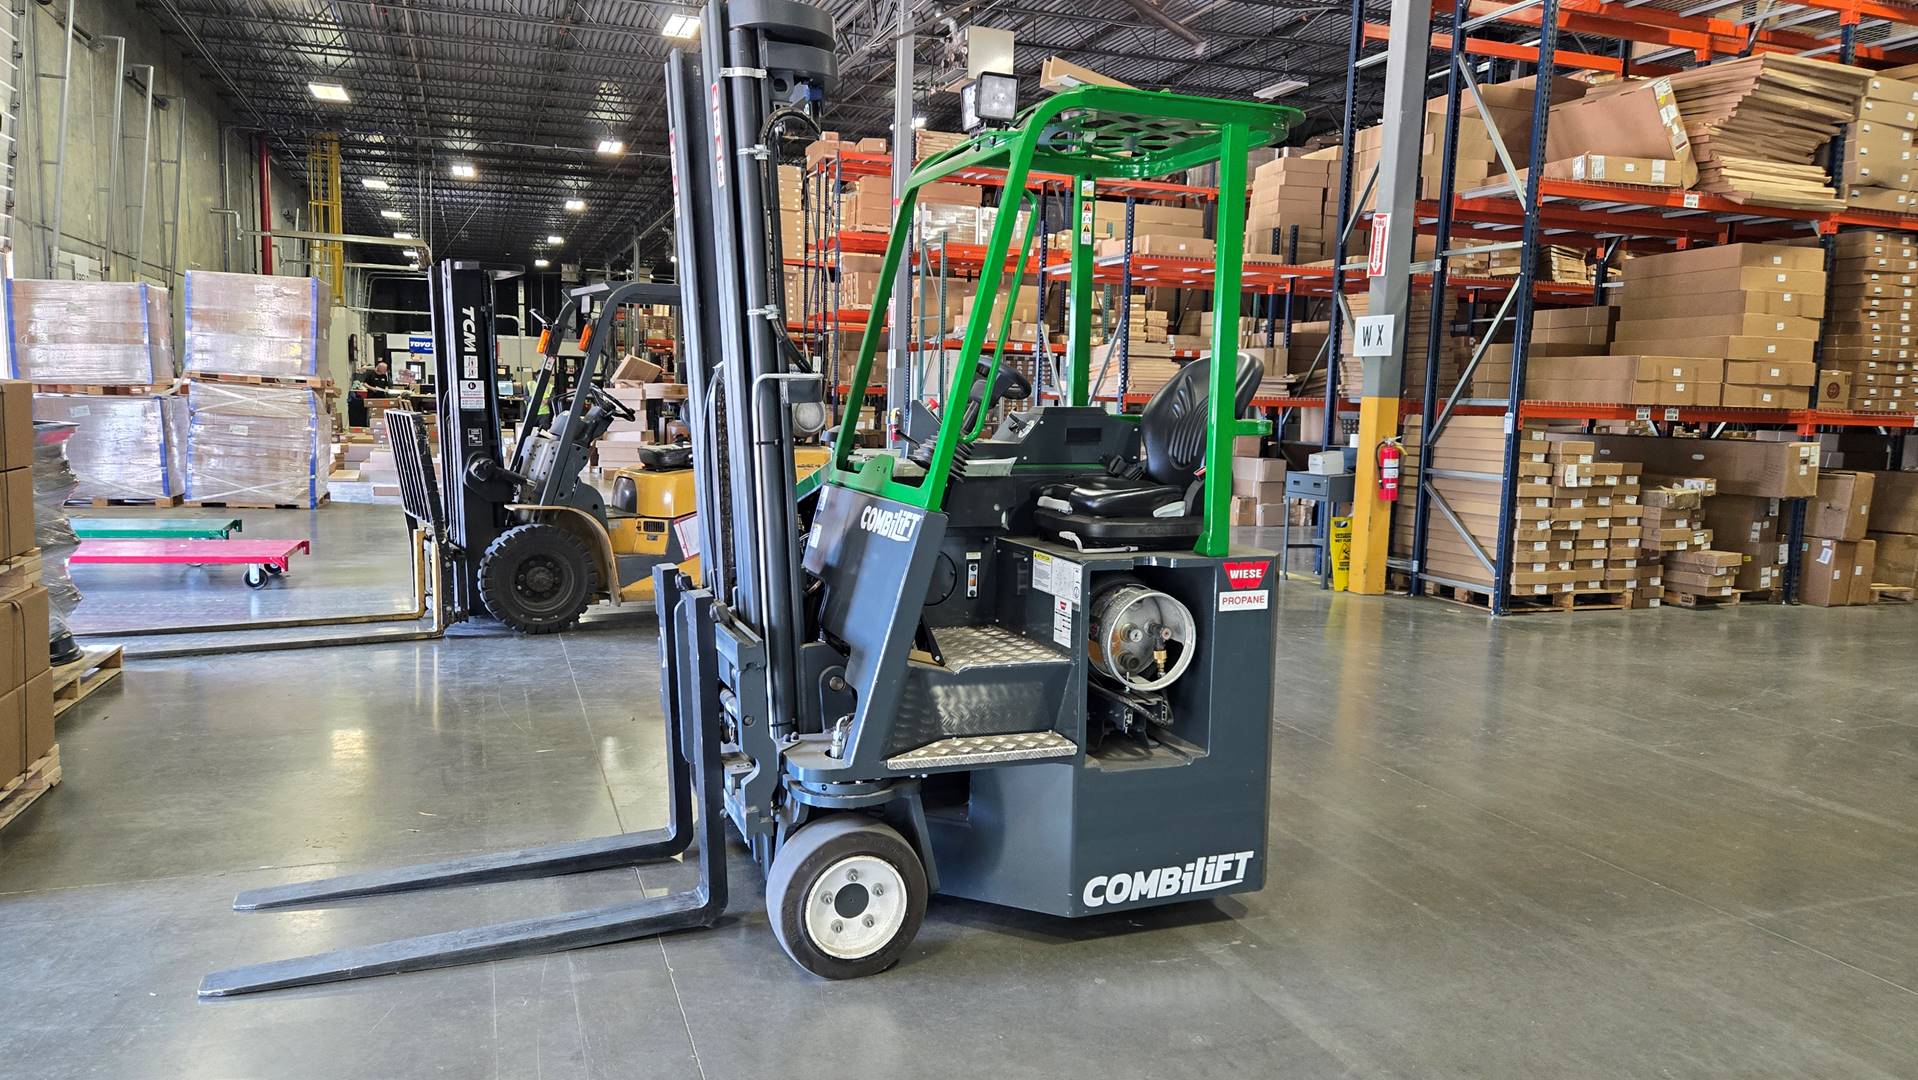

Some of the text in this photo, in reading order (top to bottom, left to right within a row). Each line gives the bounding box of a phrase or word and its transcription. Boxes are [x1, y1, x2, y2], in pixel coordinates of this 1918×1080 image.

[462, 306, 477, 353] TCM
[1229, 568, 1263, 579] WIESE
[1222, 595, 1265, 605] PROPANE
